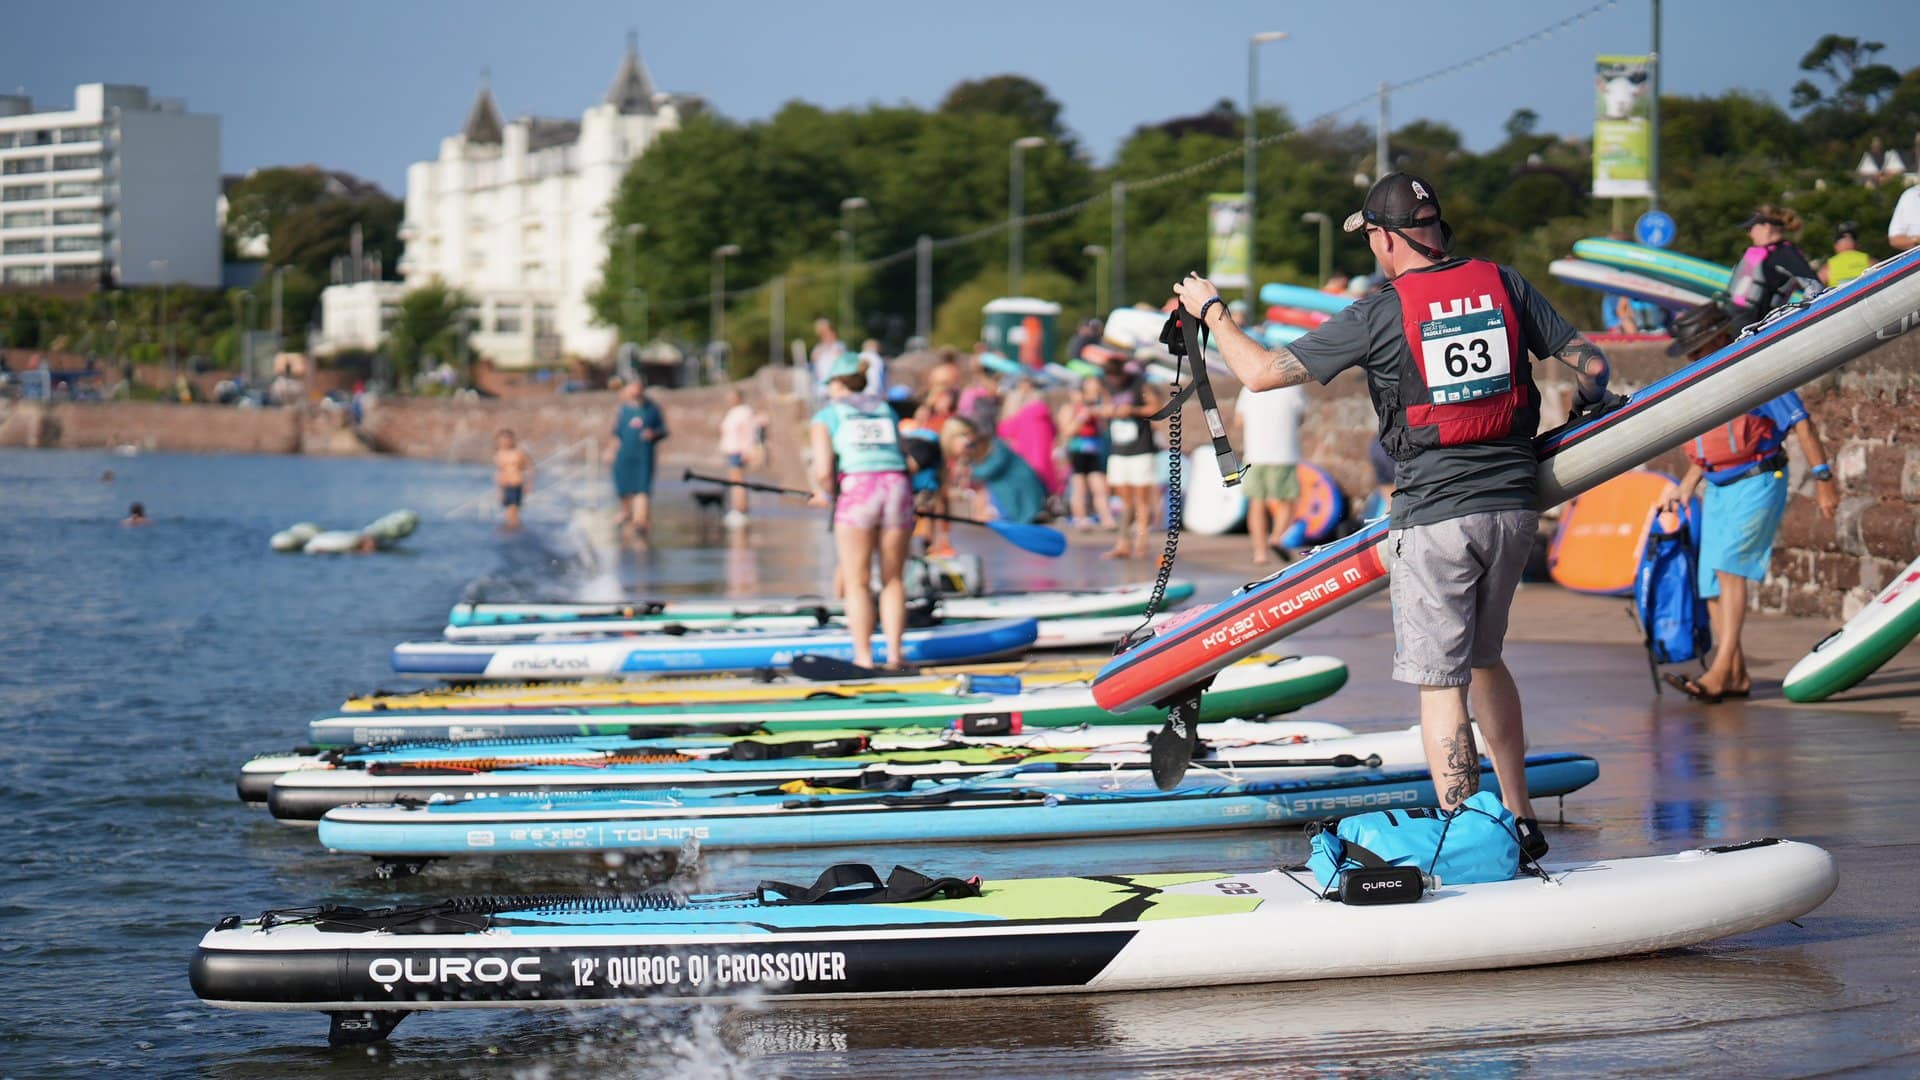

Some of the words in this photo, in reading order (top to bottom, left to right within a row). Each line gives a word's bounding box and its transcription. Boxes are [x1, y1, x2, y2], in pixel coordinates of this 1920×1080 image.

[1444, 338, 1492, 378] 63
[1294, 789, 1419, 812] STARBOARD
[612, 827, 711, 843] TOURING
[1362, 880, 1403, 892] QUROC
[368, 956, 542, 993] QUROC
[571, 957, 600, 987] 12'
[607, 954, 681, 989] QUROC
[688, 954, 710, 987] QI
[717, 951, 847, 984] CROSSOVER
